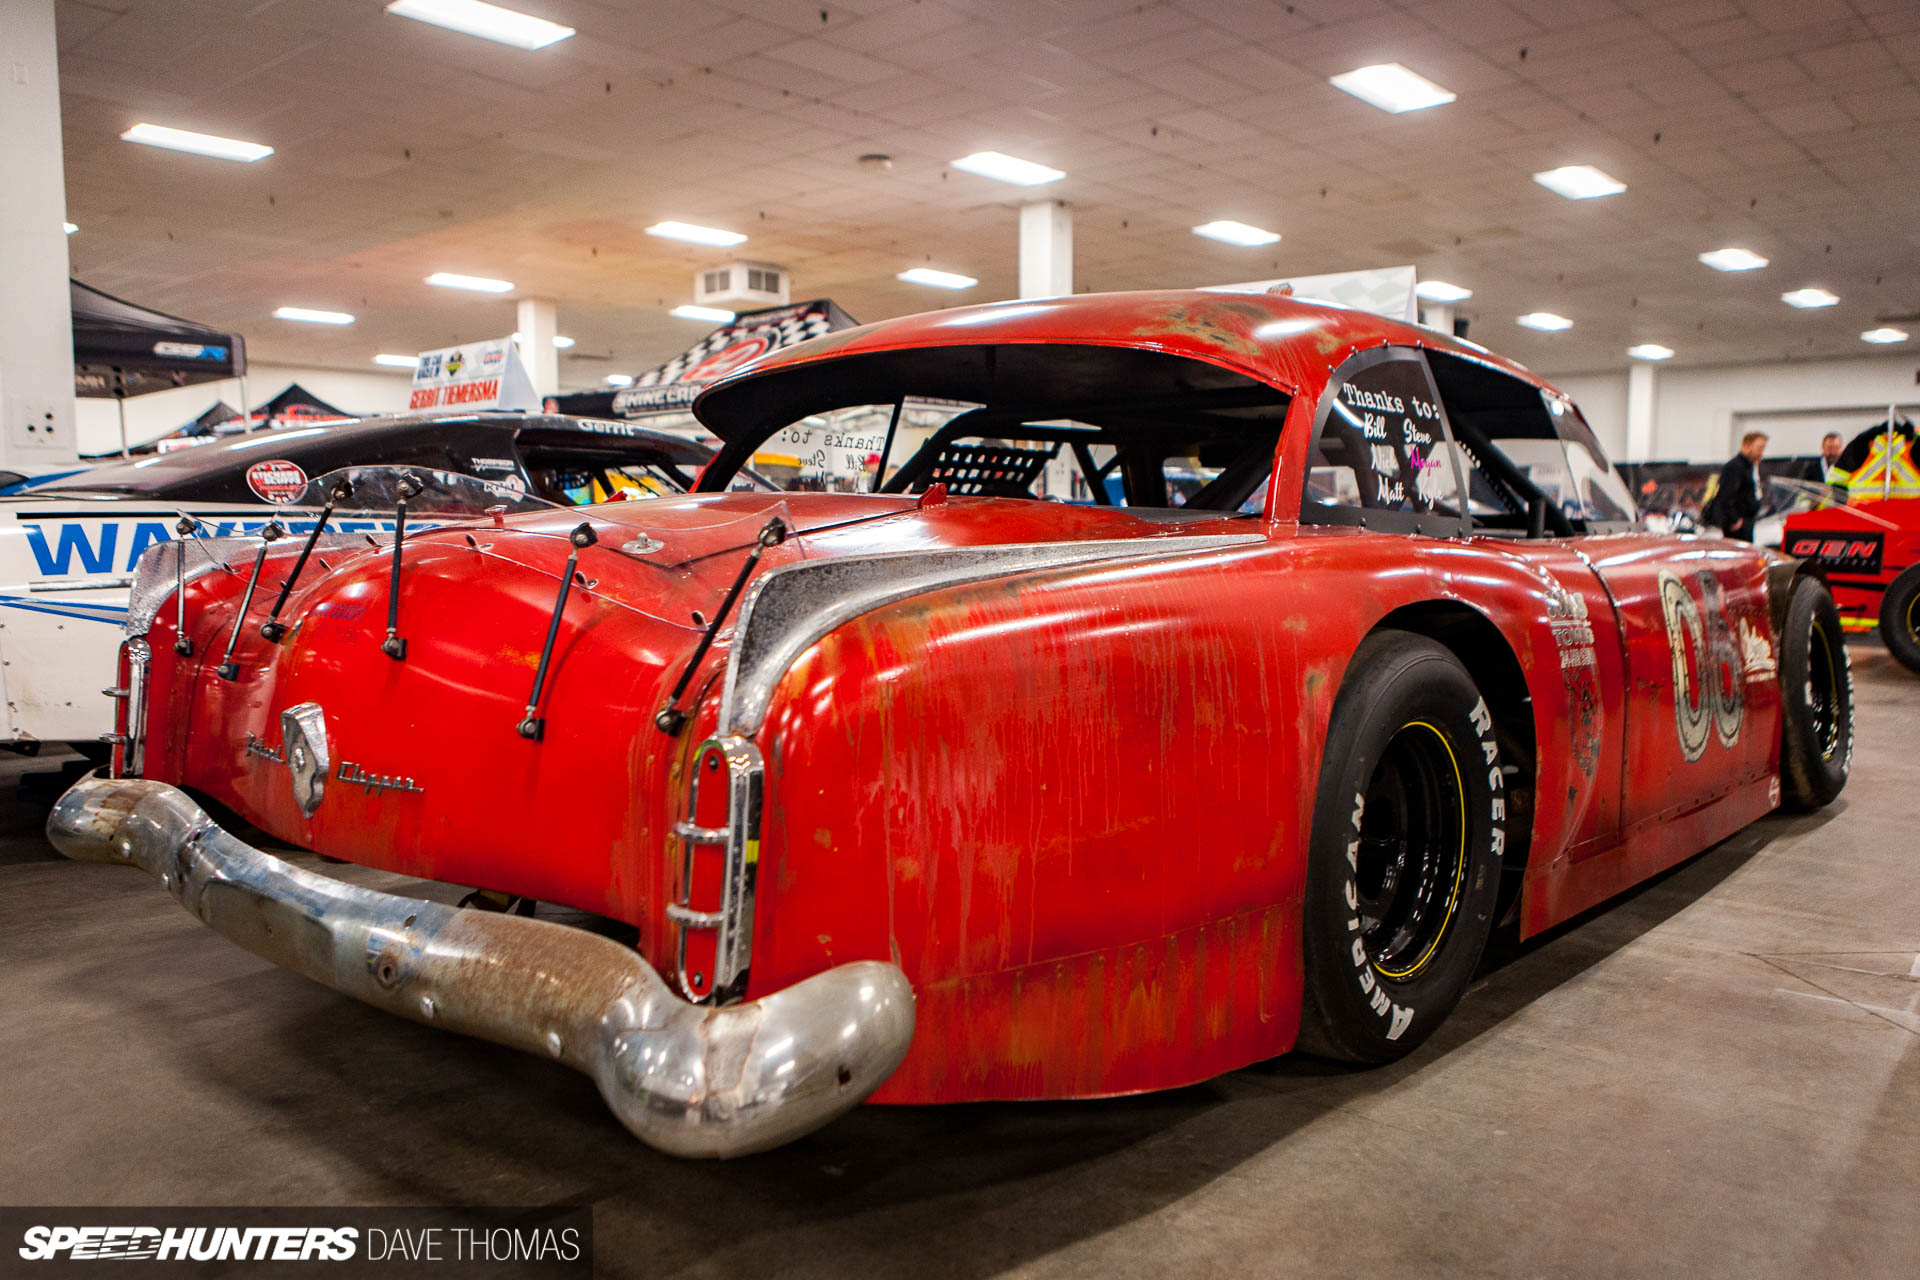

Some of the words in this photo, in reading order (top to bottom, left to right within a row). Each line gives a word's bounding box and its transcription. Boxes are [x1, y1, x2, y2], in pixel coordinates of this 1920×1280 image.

[409, 387, 441, 410] GERRIT
[442, 379, 498, 406] TIEMERSMA
[1343, 382, 1405, 414] Thanks
[1412, 396, 1440, 420] to:
[577, 418, 635, 436] Gerrit
[1364, 413, 1387, 439] Bill
[1403, 418, 1432, 444] Steve
[1410, 447, 1441, 477] Morgan
[1378, 474, 1405, 506] Matt
[1418, 480, 1445, 511] Kyle
[1792, 540, 1877, 557] GEN
[1469, 695, 1506, 857] RACER
[1345, 792, 1415, 1042] AMERICAN
